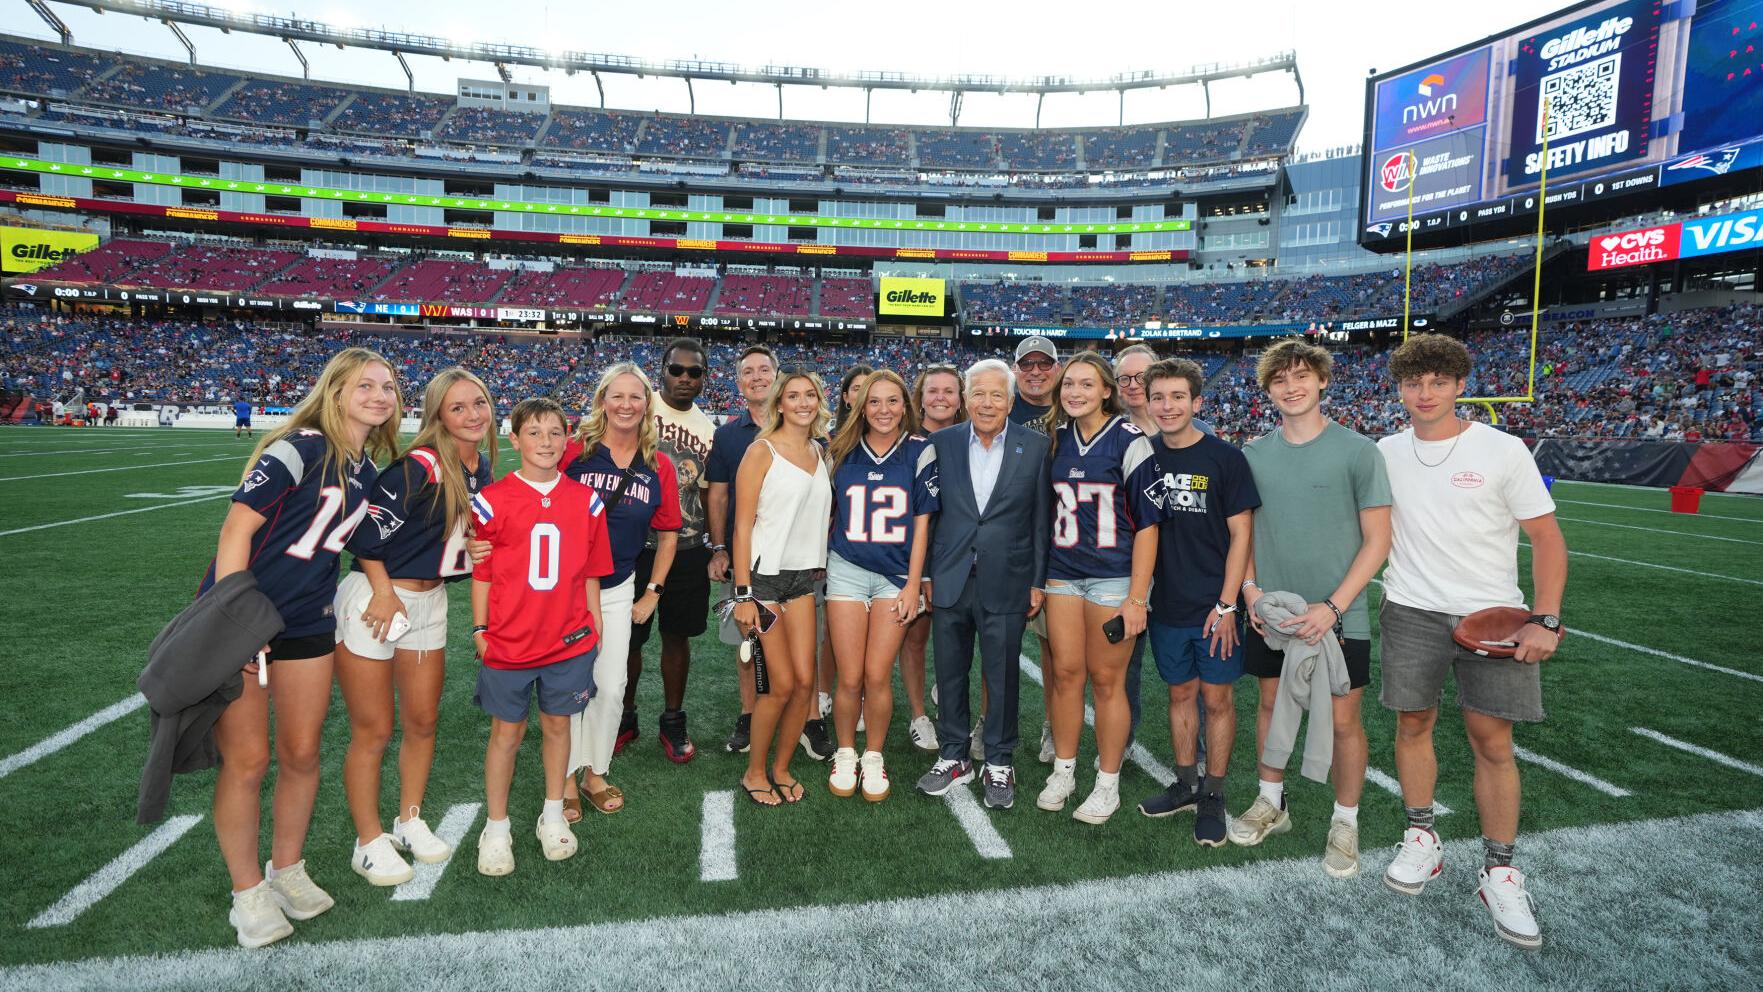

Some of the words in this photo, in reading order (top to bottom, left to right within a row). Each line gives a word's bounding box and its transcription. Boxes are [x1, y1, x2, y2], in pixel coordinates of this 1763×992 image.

[1540, 16, 1633, 60] Gillette
[1548, 36, 1621, 71] STADIUM
[1403, 94, 1456, 124] nwn
[1423, 152, 1450, 166] WASTE
[1524, 140, 1586, 175] SAFETY
[1587, 130, 1629, 160] INFO
[1447, 185, 1471, 197] PLANET
[1595, 183, 1604, 195] 0
[1612, 182, 1624, 191] 1ST
[1625, 175, 1654, 188] DOWNS
[1525, 198, 1533, 209] 0
[1545, 194, 1562, 204] RUSH
[1563, 190, 1577, 200] YDS
[1460, 211, 1467, 221] 0
[1478, 209, 1492, 217] PASS
[1494, 206, 1505, 215] YDS
[310, 218, 357, 229] COMMANDERS
[677, 240, 716, 248] COMMANDERS
[1620, 228, 1665, 249] CVS
[1008, 252, 1047, 260] COMMANDERS
[55, 288, 79, 297] 0:00
[121, 292, 128, 300] 0
[887, 290, 936, 304] Gillette
[376, 304, 388, 313] NE
[451, 307, 473, 317] WAS
[568, 312, 577, 320] 10
[1343, 321, 1368, 330] FELGER
[1376, 319, 1397, 327] MAZZ
[580, 473, 605, 489] NEW
[845, 485, 908, 543] 12
[1053, 481, 1117, 548] 87
[528, 523, 560, 591] 0
